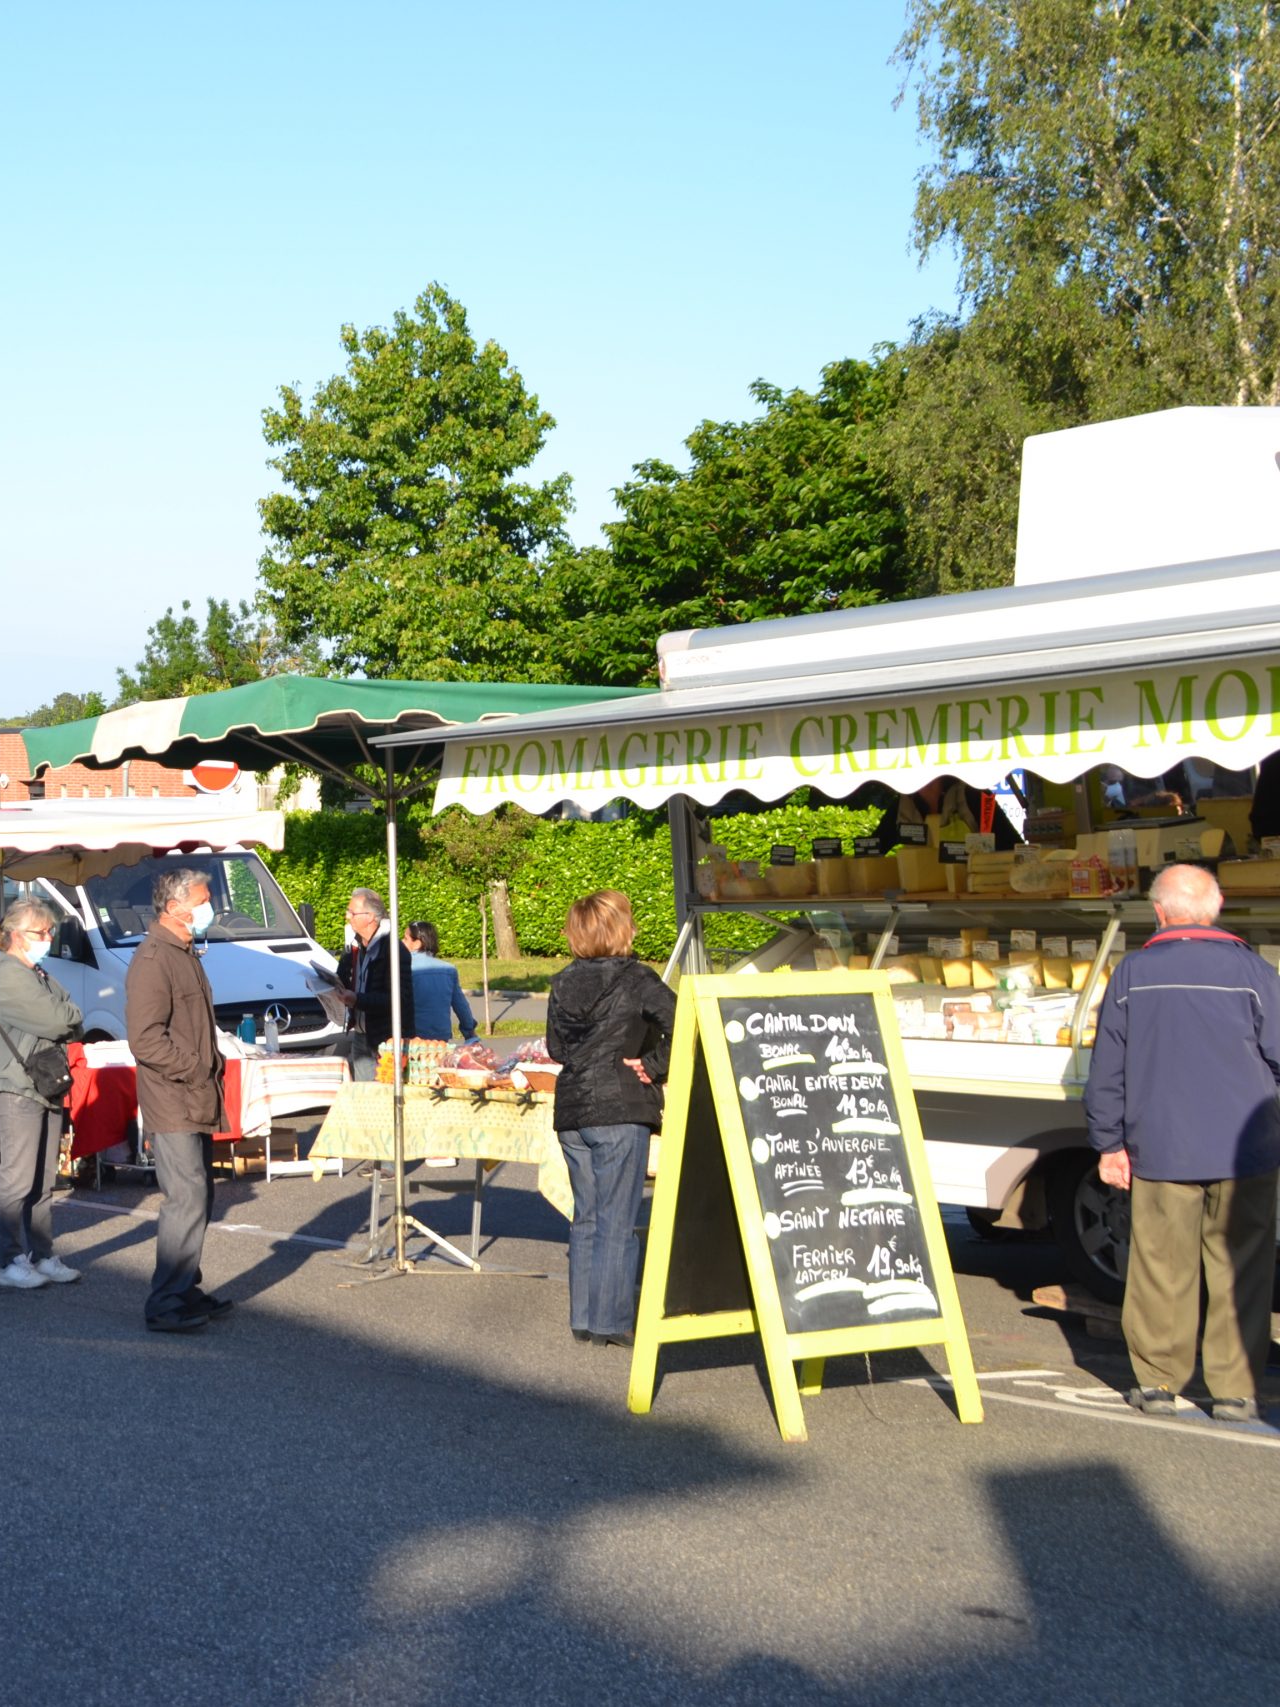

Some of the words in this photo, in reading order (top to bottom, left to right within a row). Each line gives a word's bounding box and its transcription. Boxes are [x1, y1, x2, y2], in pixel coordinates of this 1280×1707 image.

[458, 722, 764, 795] FROMAGERIE
[789, 686, 1107, 778] CREMERIE
[746, 1012, 809, 1035] CANTAL
[809, 1013, 860, 1036] DOUX
[755, 1074, 799, 1094] CANTAL
[804, 1075, 849, 1091] ENTRE
[851, 1075, 884, 1091] DEUX
[765, 1132, 801, 1156] TOME
